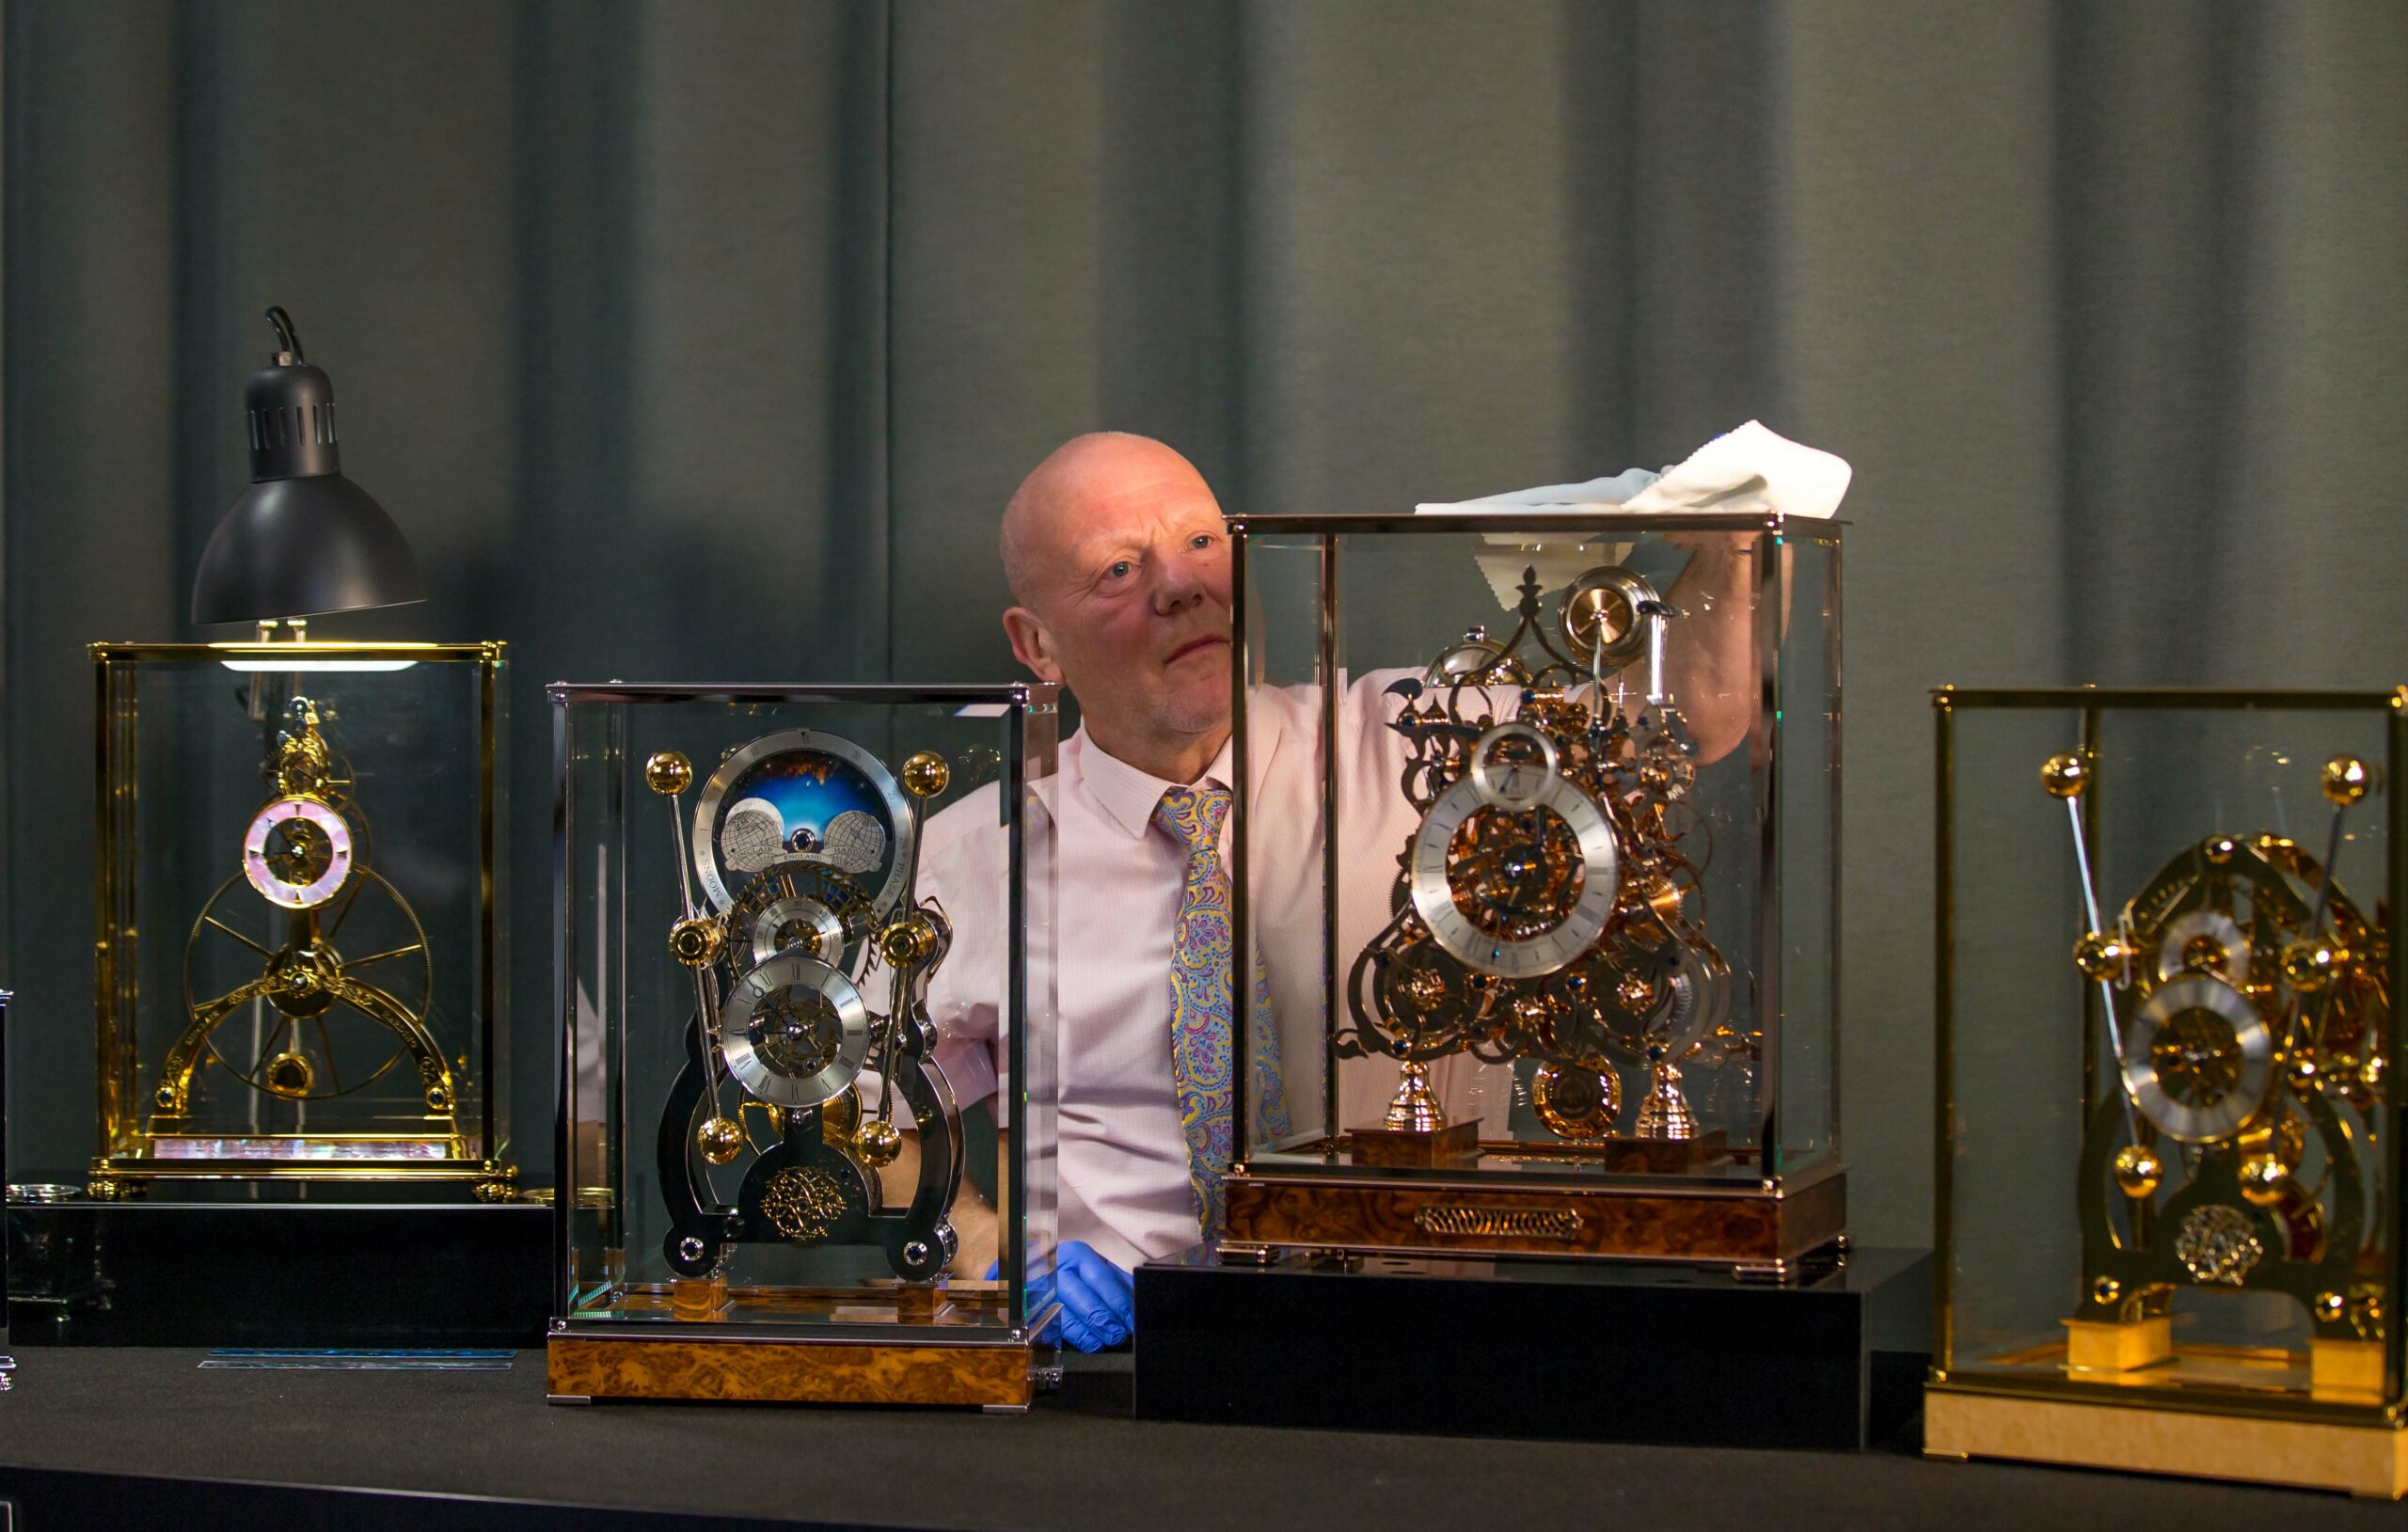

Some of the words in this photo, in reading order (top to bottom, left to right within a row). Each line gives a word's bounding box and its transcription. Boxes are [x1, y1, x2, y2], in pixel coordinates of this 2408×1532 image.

[751, 747, 760, 757] 10
[887, 790, 896, 800] 25
[733, 846, 773, 860] SINCLAIR
[833, 847, 873, 862] HARDING
[702, 859, 722, 898] MOONS
[885, 862, 905, 897] PHASE
[759, 971, 773, 987] XI
[790, 963, 800, 981] XII
